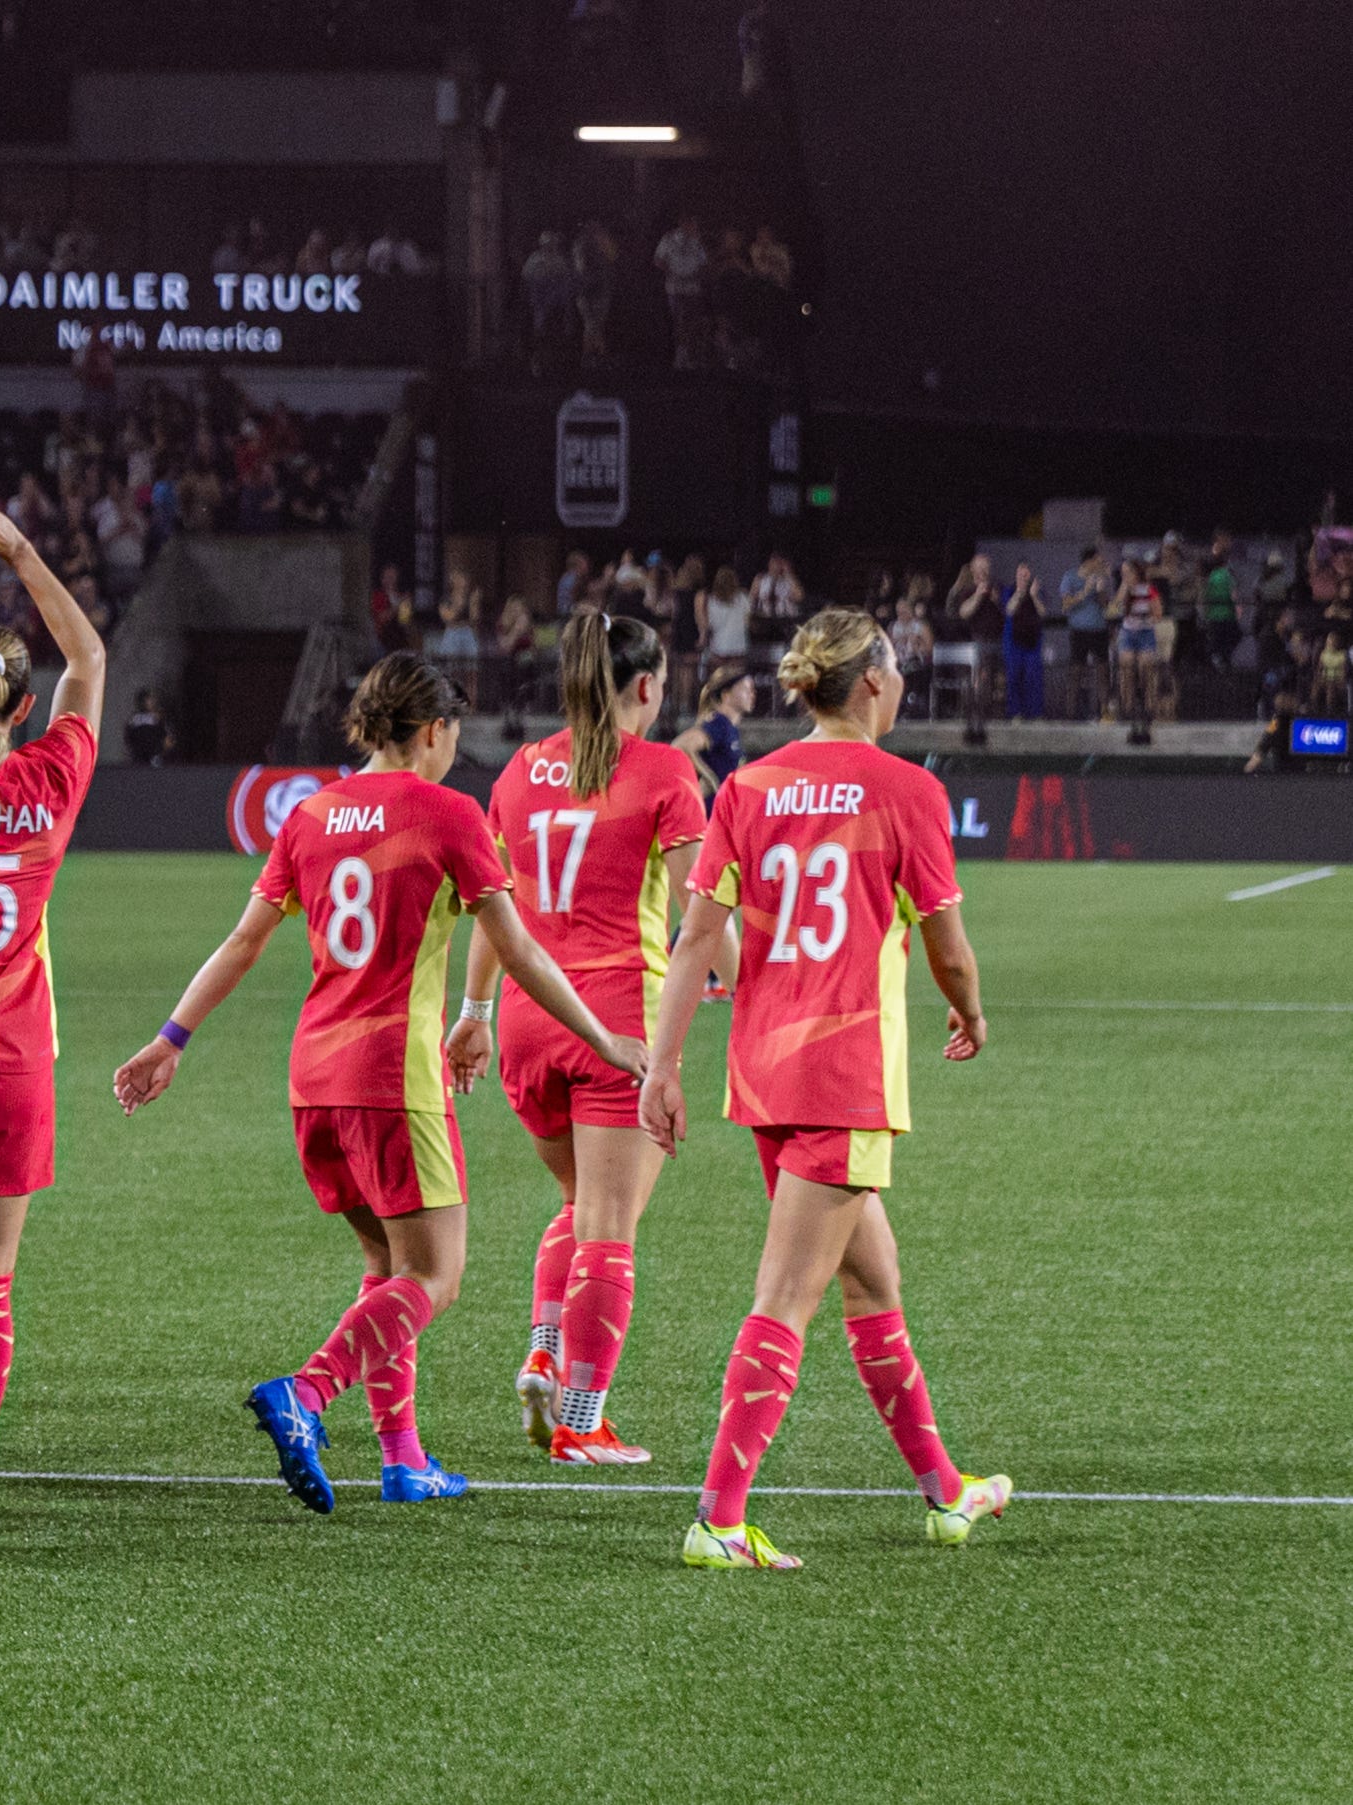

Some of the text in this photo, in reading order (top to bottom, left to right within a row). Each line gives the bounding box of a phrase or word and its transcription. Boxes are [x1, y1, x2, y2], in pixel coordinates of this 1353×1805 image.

[213, 272, 363, 313] TRUCK
[157, 320, 283, 353] America
[765, 778, 864, 817] MÜLLER
[325, 804, 386, 836] HINA
[528, 809, 597, 913] 17
[326, 856, 377, 970] 8
[760, 842, 850, 963] 23
